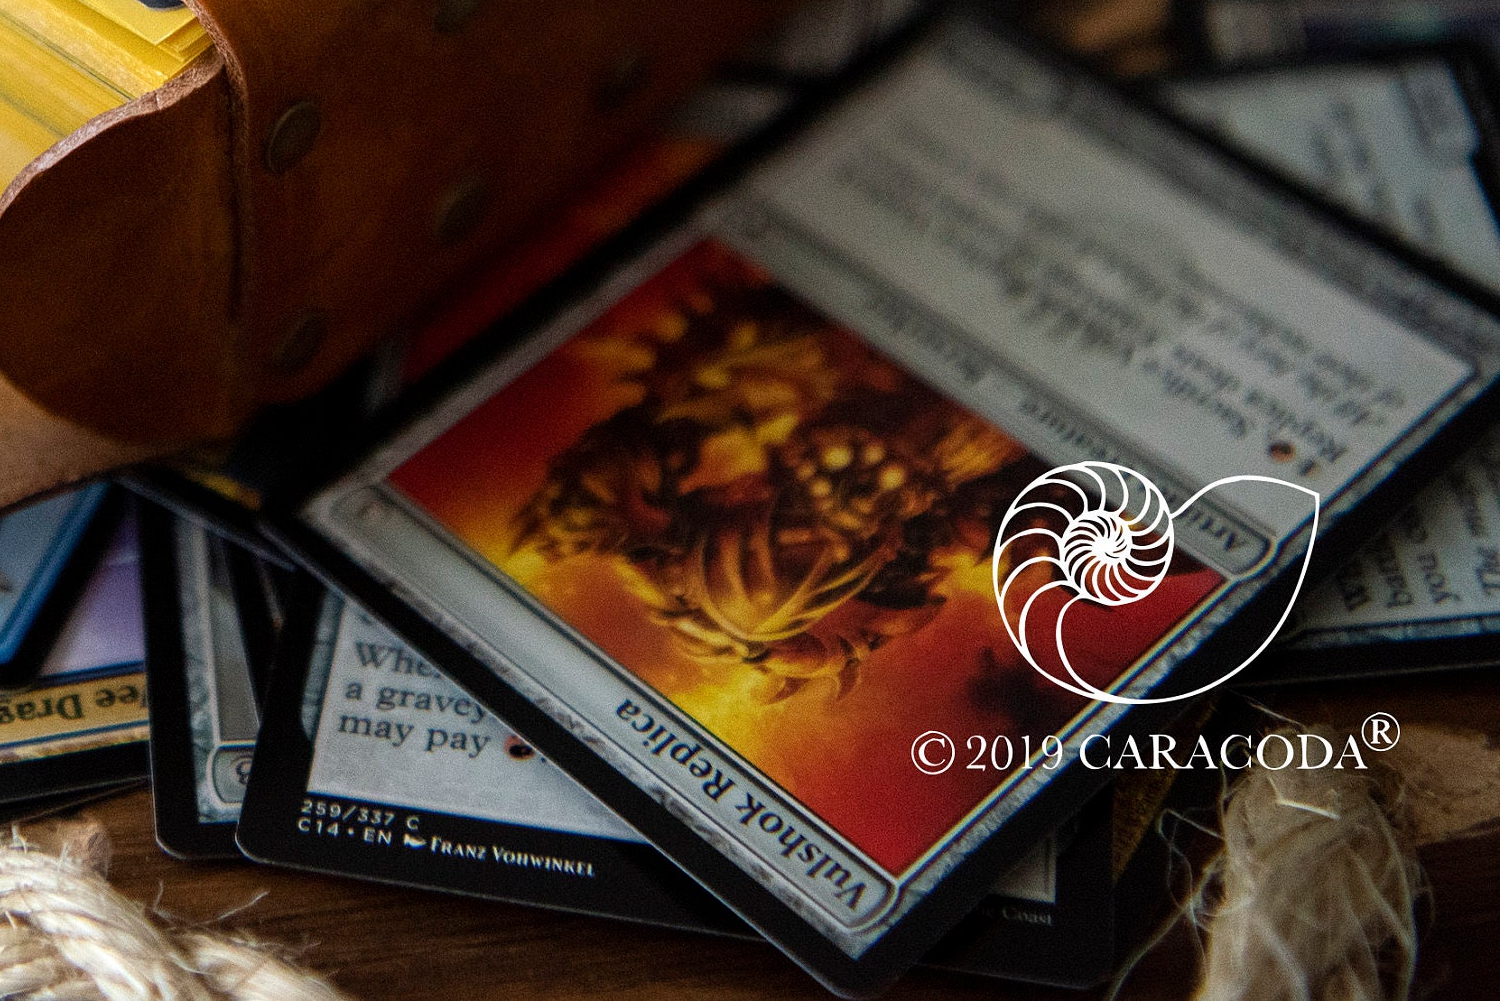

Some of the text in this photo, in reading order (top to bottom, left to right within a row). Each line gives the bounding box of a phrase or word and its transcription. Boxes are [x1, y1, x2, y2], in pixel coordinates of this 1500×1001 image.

[355, 640, 442, 680] Whe
[345, 682, 363, 701] a
[337, 713, 492, 759] may pay
[300, 799, 420, 831] 259/337 C
[615, 698, 868, 911] Vulshok Replica
[297, 816, 340, 838] C14
[363, 827, 392, 846] EN
